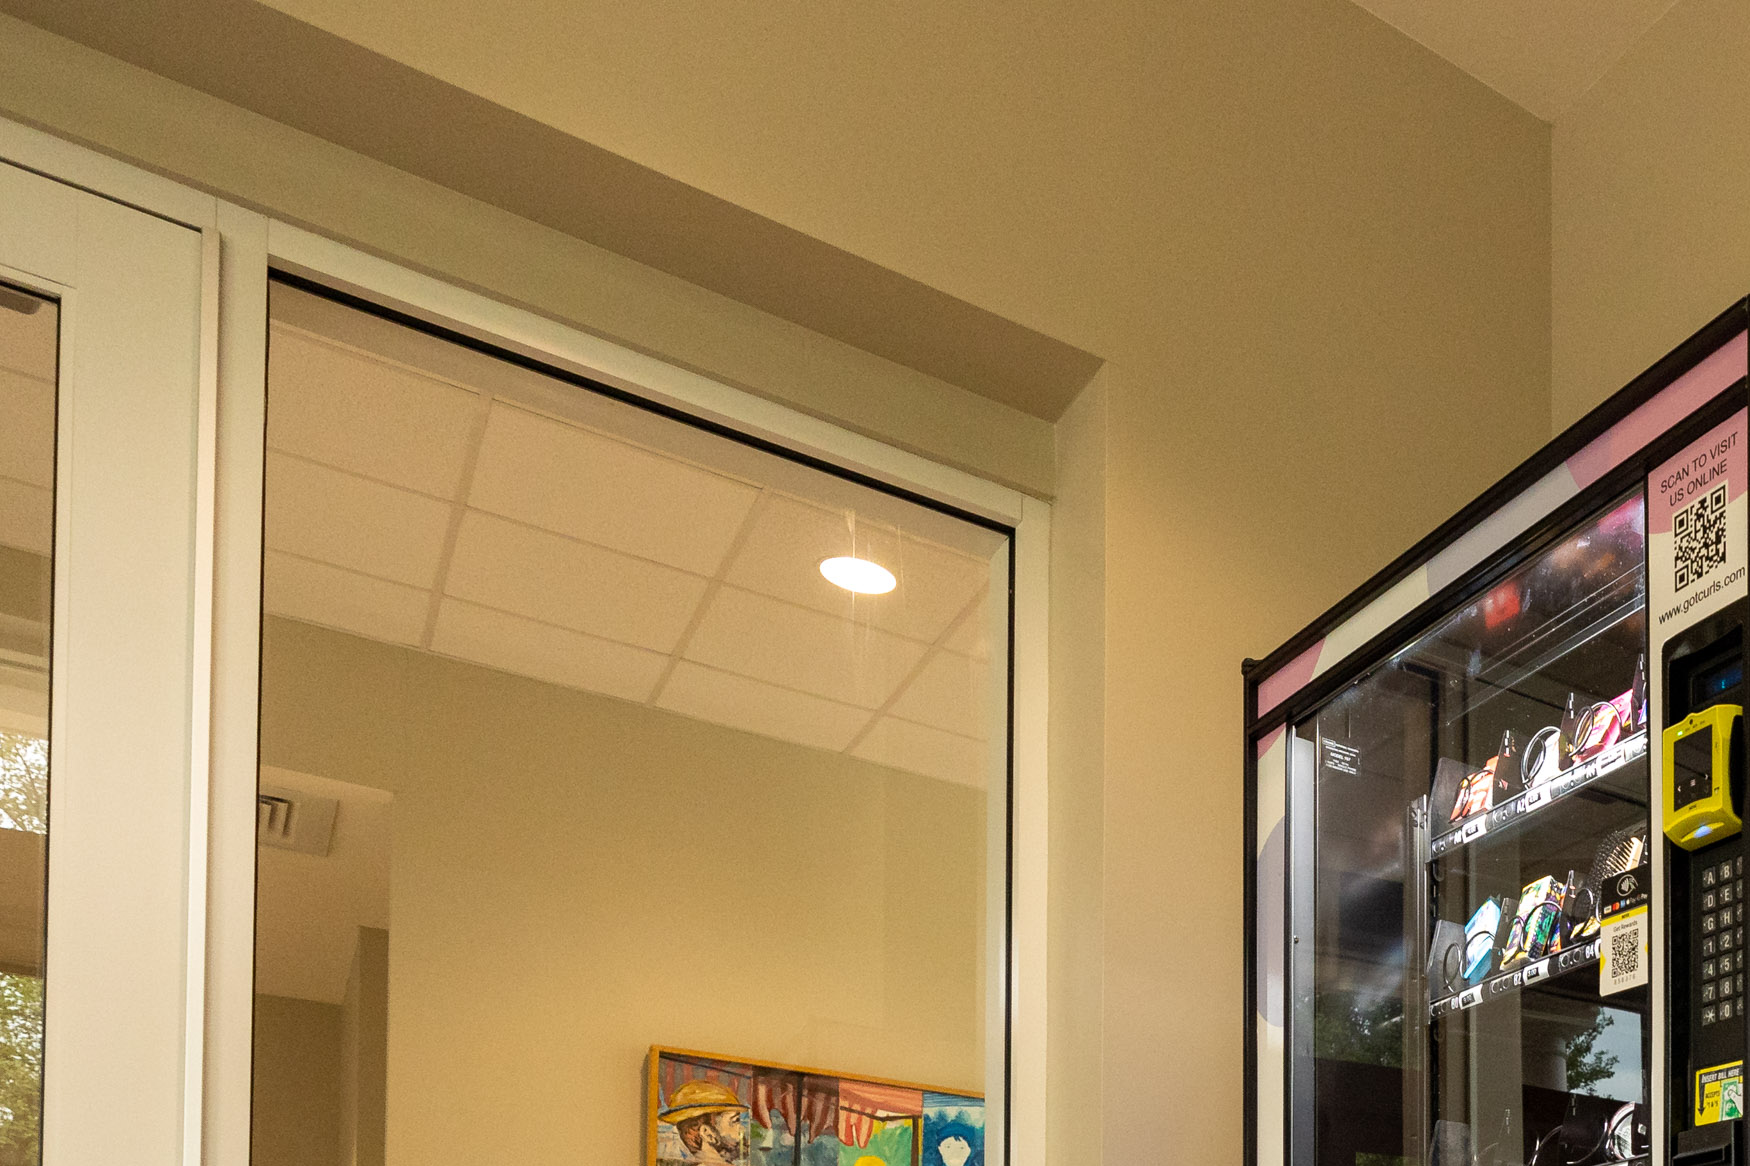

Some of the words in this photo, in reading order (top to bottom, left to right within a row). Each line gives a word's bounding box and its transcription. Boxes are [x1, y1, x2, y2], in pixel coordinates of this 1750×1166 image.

[1660, 465, 1689, 494] SCAN
[1692, 454, 1707, 470] TO
[1710, 432, 1738, 460] VISIT
[1669, 490, 1684, 507] US
[1687, 459, 1728, 496] ONLINE
[1658, 566, 1746, 625] www.gotcurls.com
[1701, 1073, 1717, 1084] INSERT
[1718, 1071, 1727, 1080] BILL
[1728, 1069, 1740, 1078] HERE
